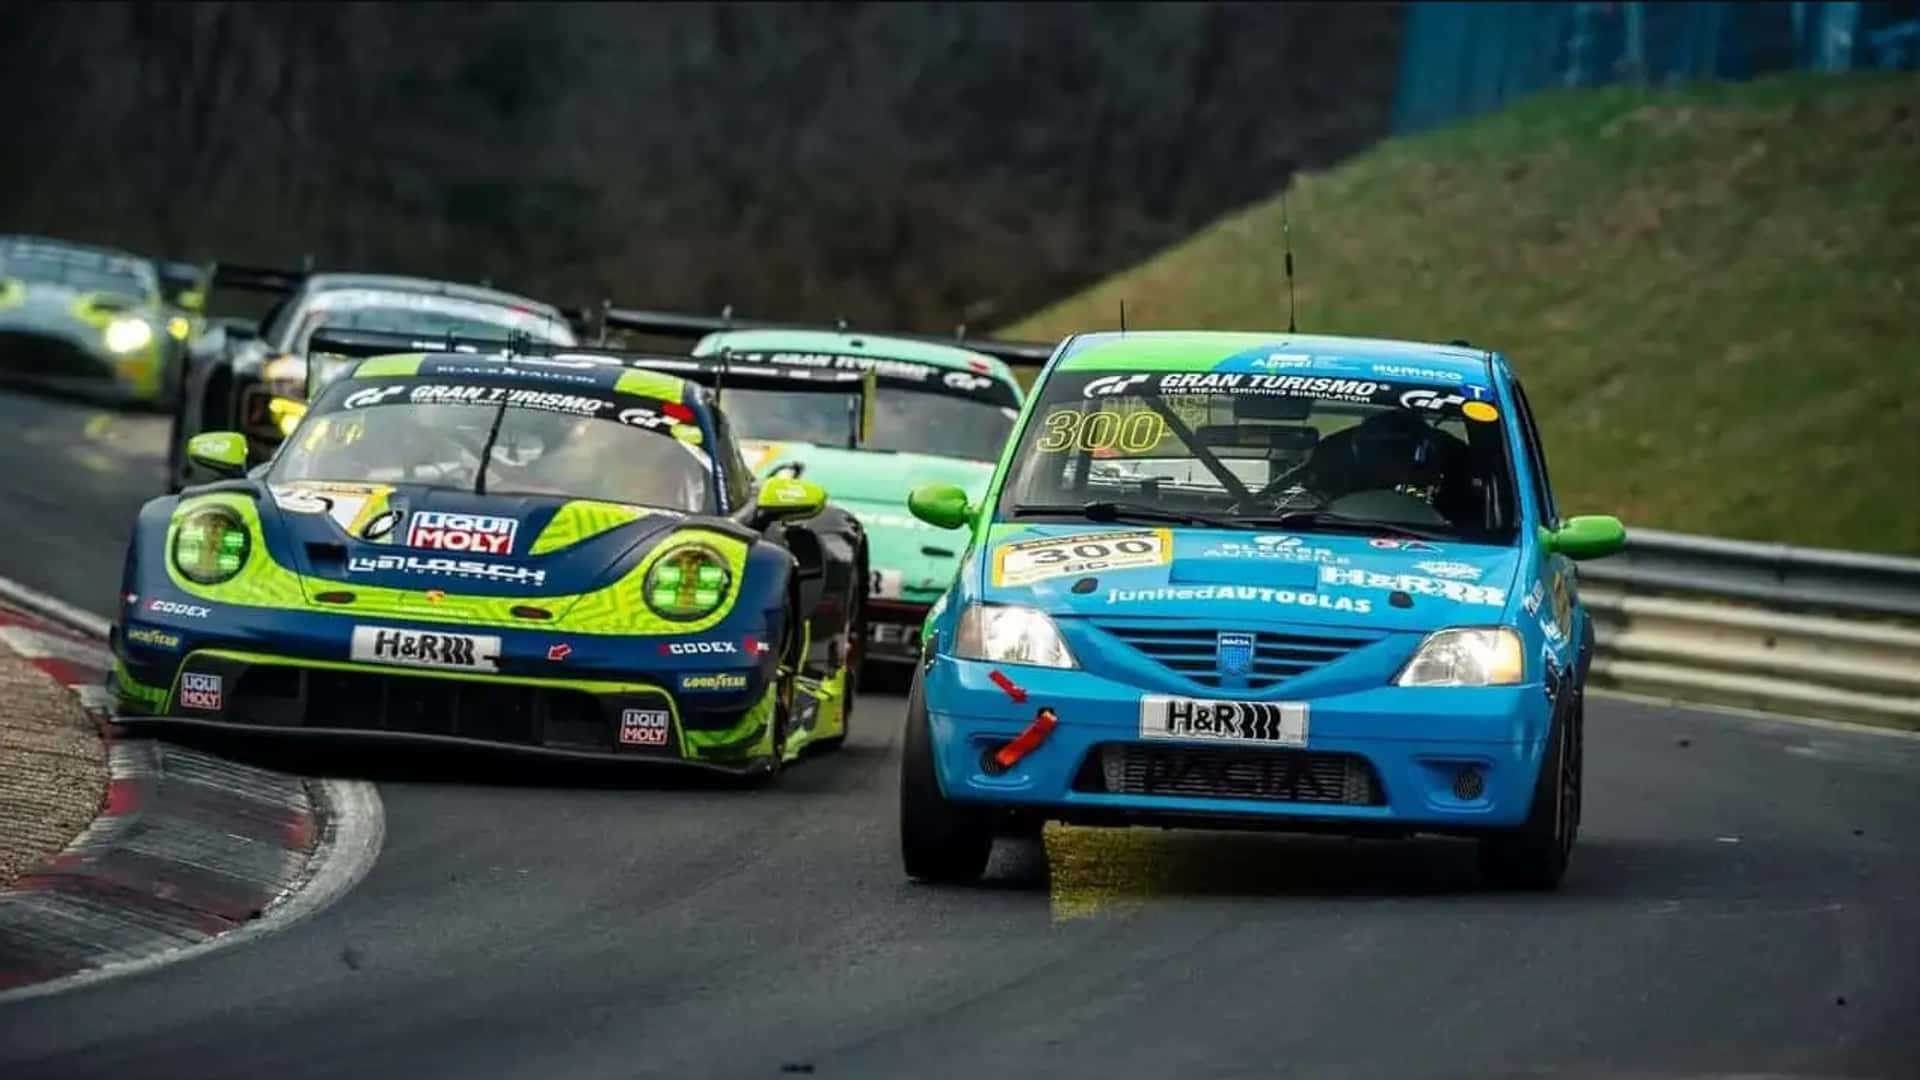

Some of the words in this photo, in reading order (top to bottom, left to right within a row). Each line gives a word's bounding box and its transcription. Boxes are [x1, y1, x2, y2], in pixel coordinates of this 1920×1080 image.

[410, 385, 486, 401] GRAN
[1160, 373, 1241, 388] GRAN
[1250, 373, 1379, 396] TURISMO
[1161, 387, 1184, 395] THE
[1228, 388, 1288, 396] DRIVING
[1289, 391, 1371, 404] SIMULATOR
[1036, 409, 1164, 453] 300
[414, 530, 509, 553] MOLY
[1030, 539, 1153, 564] 300
[151, 600, 213, 618] CODEX
[669, 641, 736, 654] CODEX
[184, 675, 218, 691] LIQUI
[626, 713, 665, 726] LIQUI
[624, 727, 666, 741] MOLY
